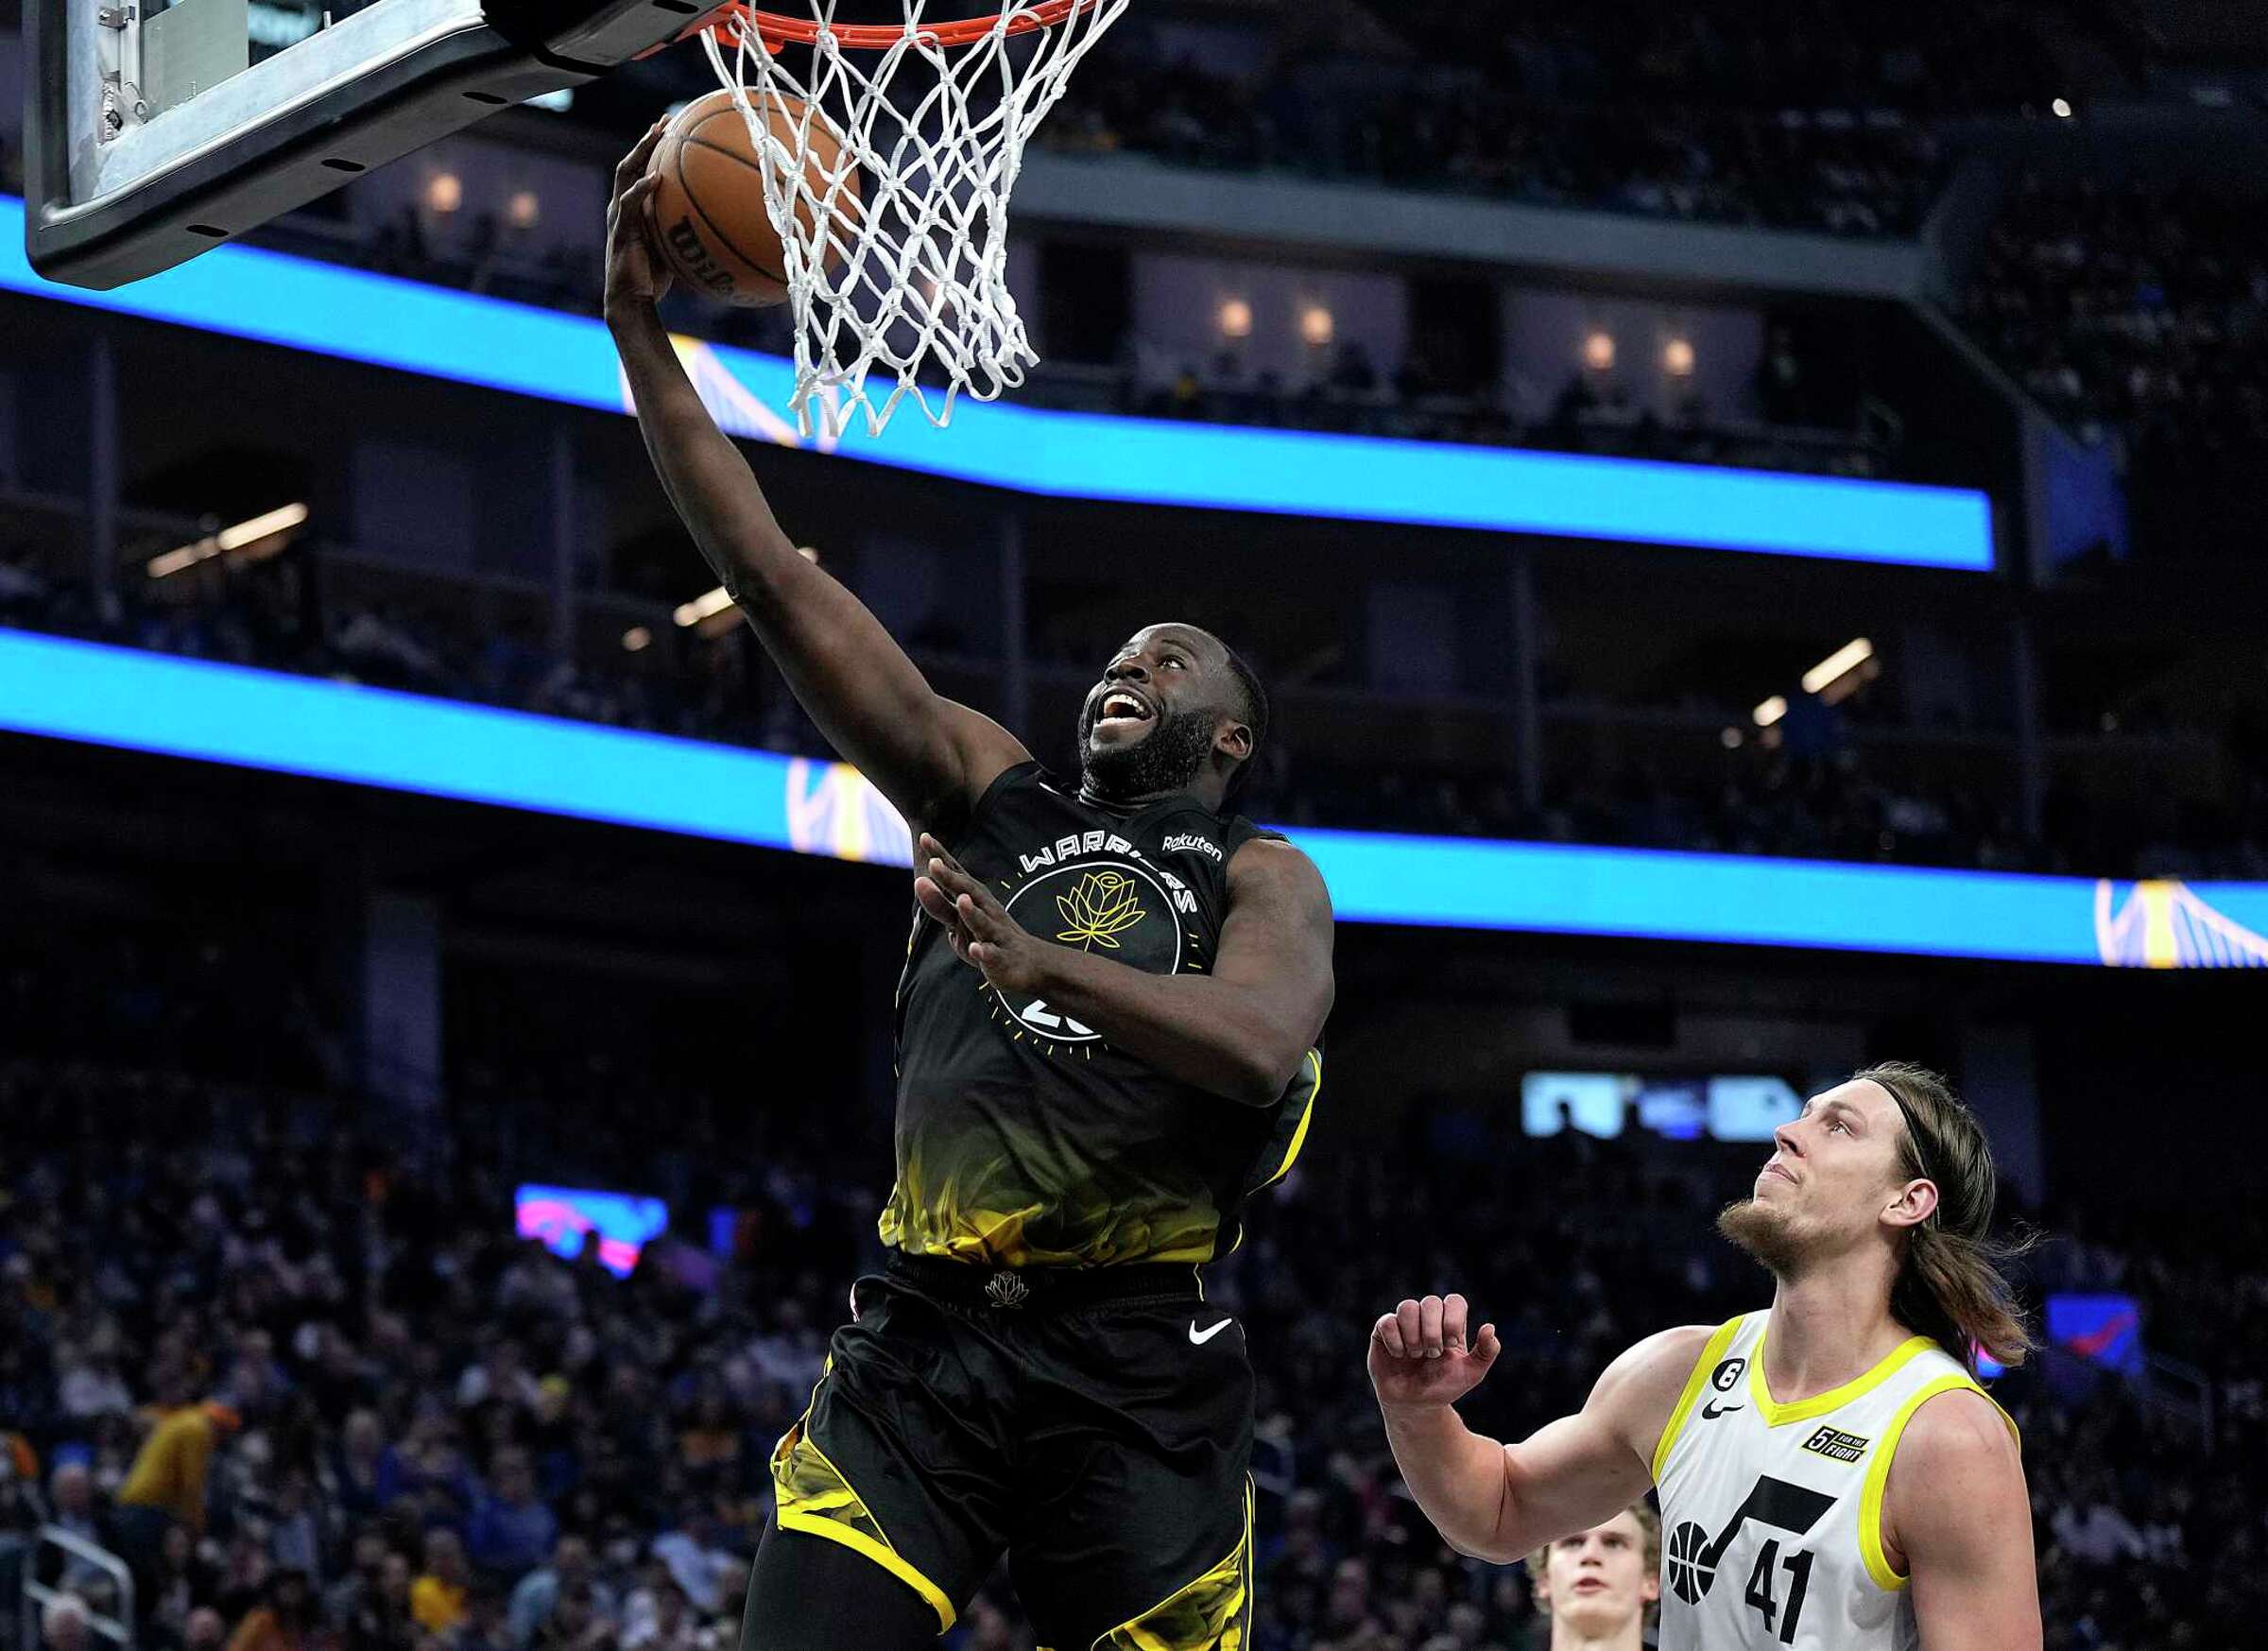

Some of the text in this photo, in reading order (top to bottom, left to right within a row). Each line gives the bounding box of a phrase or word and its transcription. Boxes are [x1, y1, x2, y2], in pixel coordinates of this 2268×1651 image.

[1162, 833, 1223, 862] Rakuten
[1019, 831, 1197, 914] WARRRS
[1718, 1362, 1742, 1388] 6
[1809, 1428, 1834, 1450] 5
[1825, 1444, 1862, 1461] FIGHT
[1745, 1538, 1814, 1645] 41
